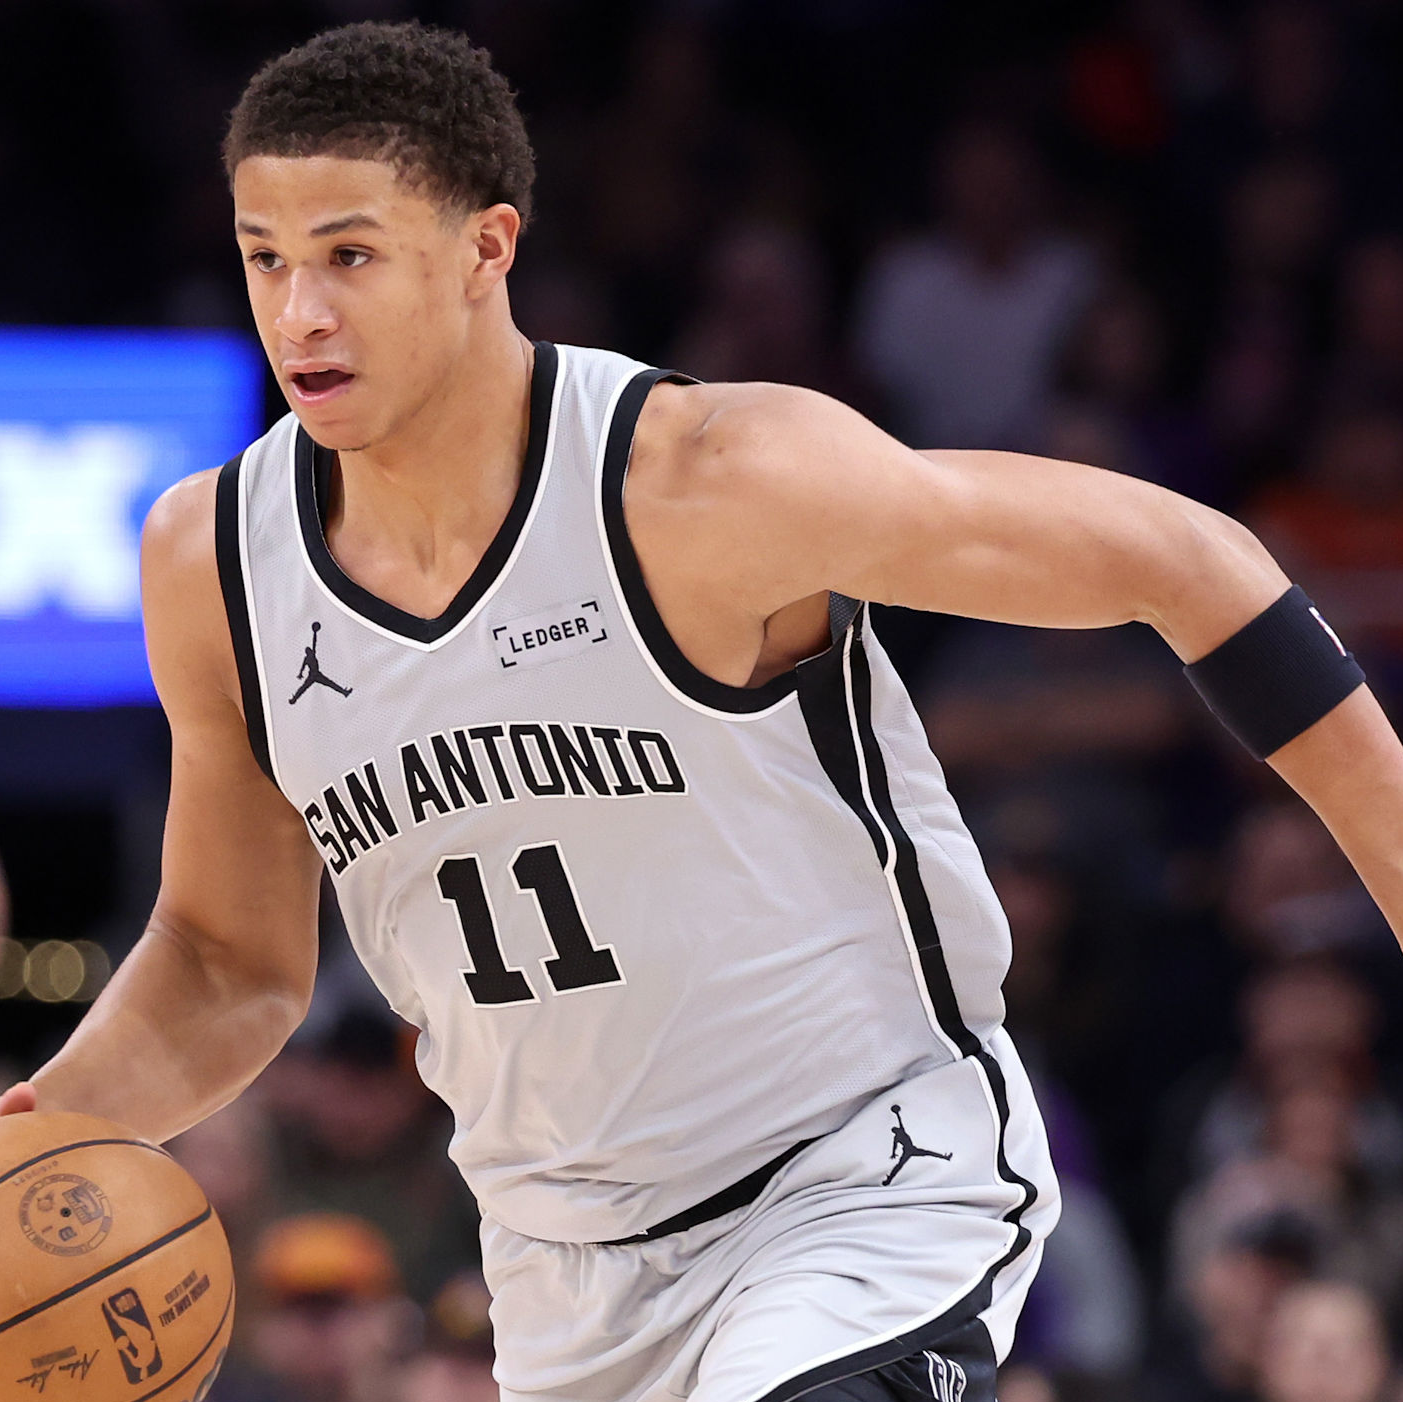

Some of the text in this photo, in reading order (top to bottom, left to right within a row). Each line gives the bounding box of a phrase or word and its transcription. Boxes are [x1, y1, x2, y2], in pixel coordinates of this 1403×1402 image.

[508, 616, 591, 654] LEDGER
[304, 721, 689, 877] SAN ANTONIO
[433, 840, 627, 1008] 11
